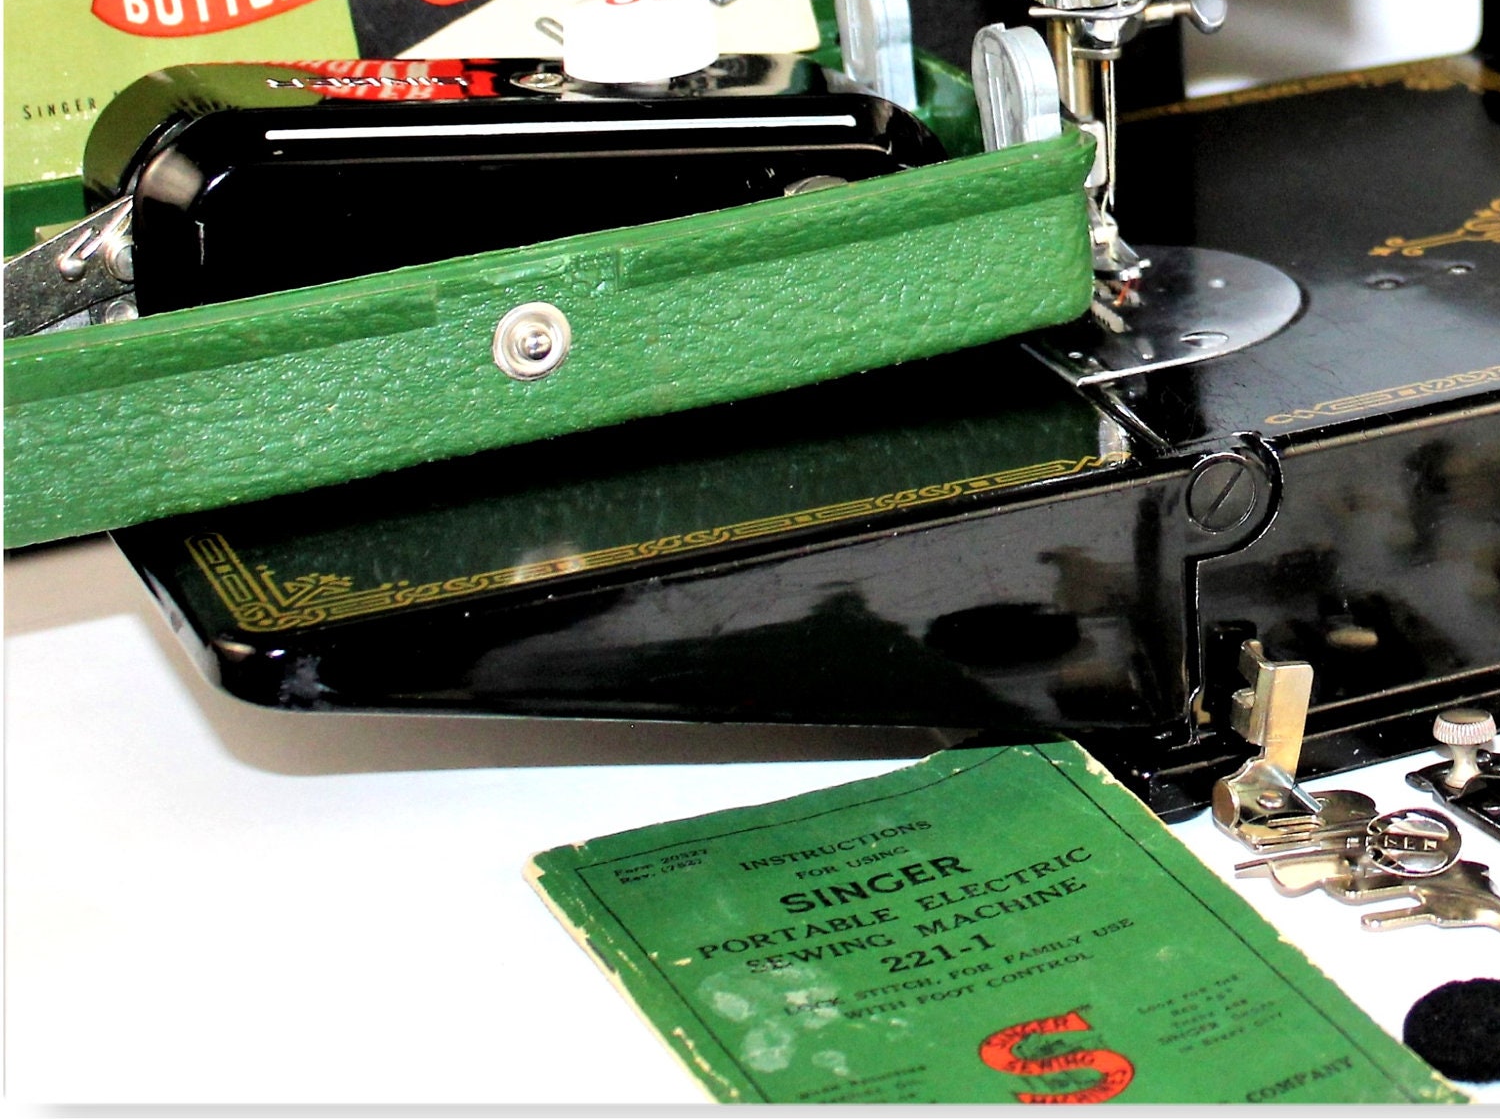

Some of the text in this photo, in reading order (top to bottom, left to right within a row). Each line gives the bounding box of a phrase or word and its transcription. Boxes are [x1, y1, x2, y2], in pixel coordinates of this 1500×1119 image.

[22, 97, 97, 120] SINGER
[739, 820, 933, 872] INSTRUCTIONS
[795, 845, 911, 880] FOR USING
[696, 846, 1093, 960] PORTABLE ELECTRIC
[779, 855, 973, 914] SINGER
[745, 876, 1088, 974] SEWING MACHINE
[949, 962, 993, 981] FOR
[1003, 935, 1083, 964] FAMILY
[1091, 918, 1135, 938] USE
[880, 933, 997, 974] 221-1
[843, 951, 1096, 1021] WITH FOOT CONTROL
[1245, 1055, 1354, 1103] COMPANY
